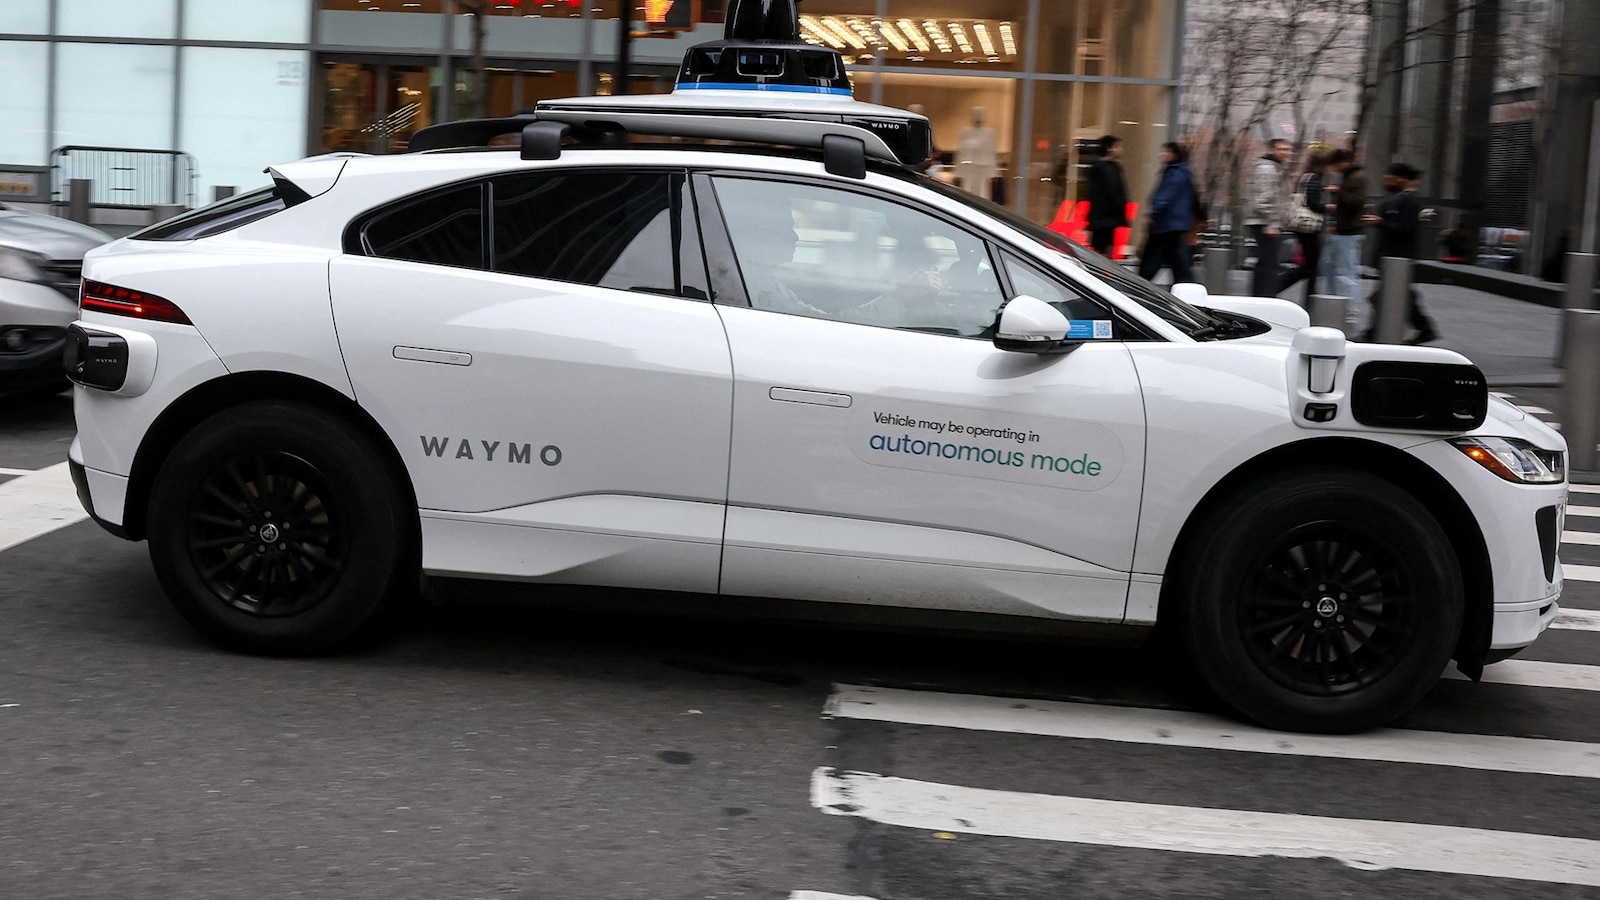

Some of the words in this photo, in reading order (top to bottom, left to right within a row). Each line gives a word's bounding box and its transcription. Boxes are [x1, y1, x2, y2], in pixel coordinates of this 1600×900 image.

[873, 411, 916, 428] Vehicle
[918, 419, 946, 433] may
[948, 421, 964, 434] be
[966, 426, 1026, 443] operating
[1028, 430, 1040, 443] in
[420, 435, 562, 466] WAYMO
[869, 434, 1024, 467] autonomous
[1030, 453, 1102, 477] mode
